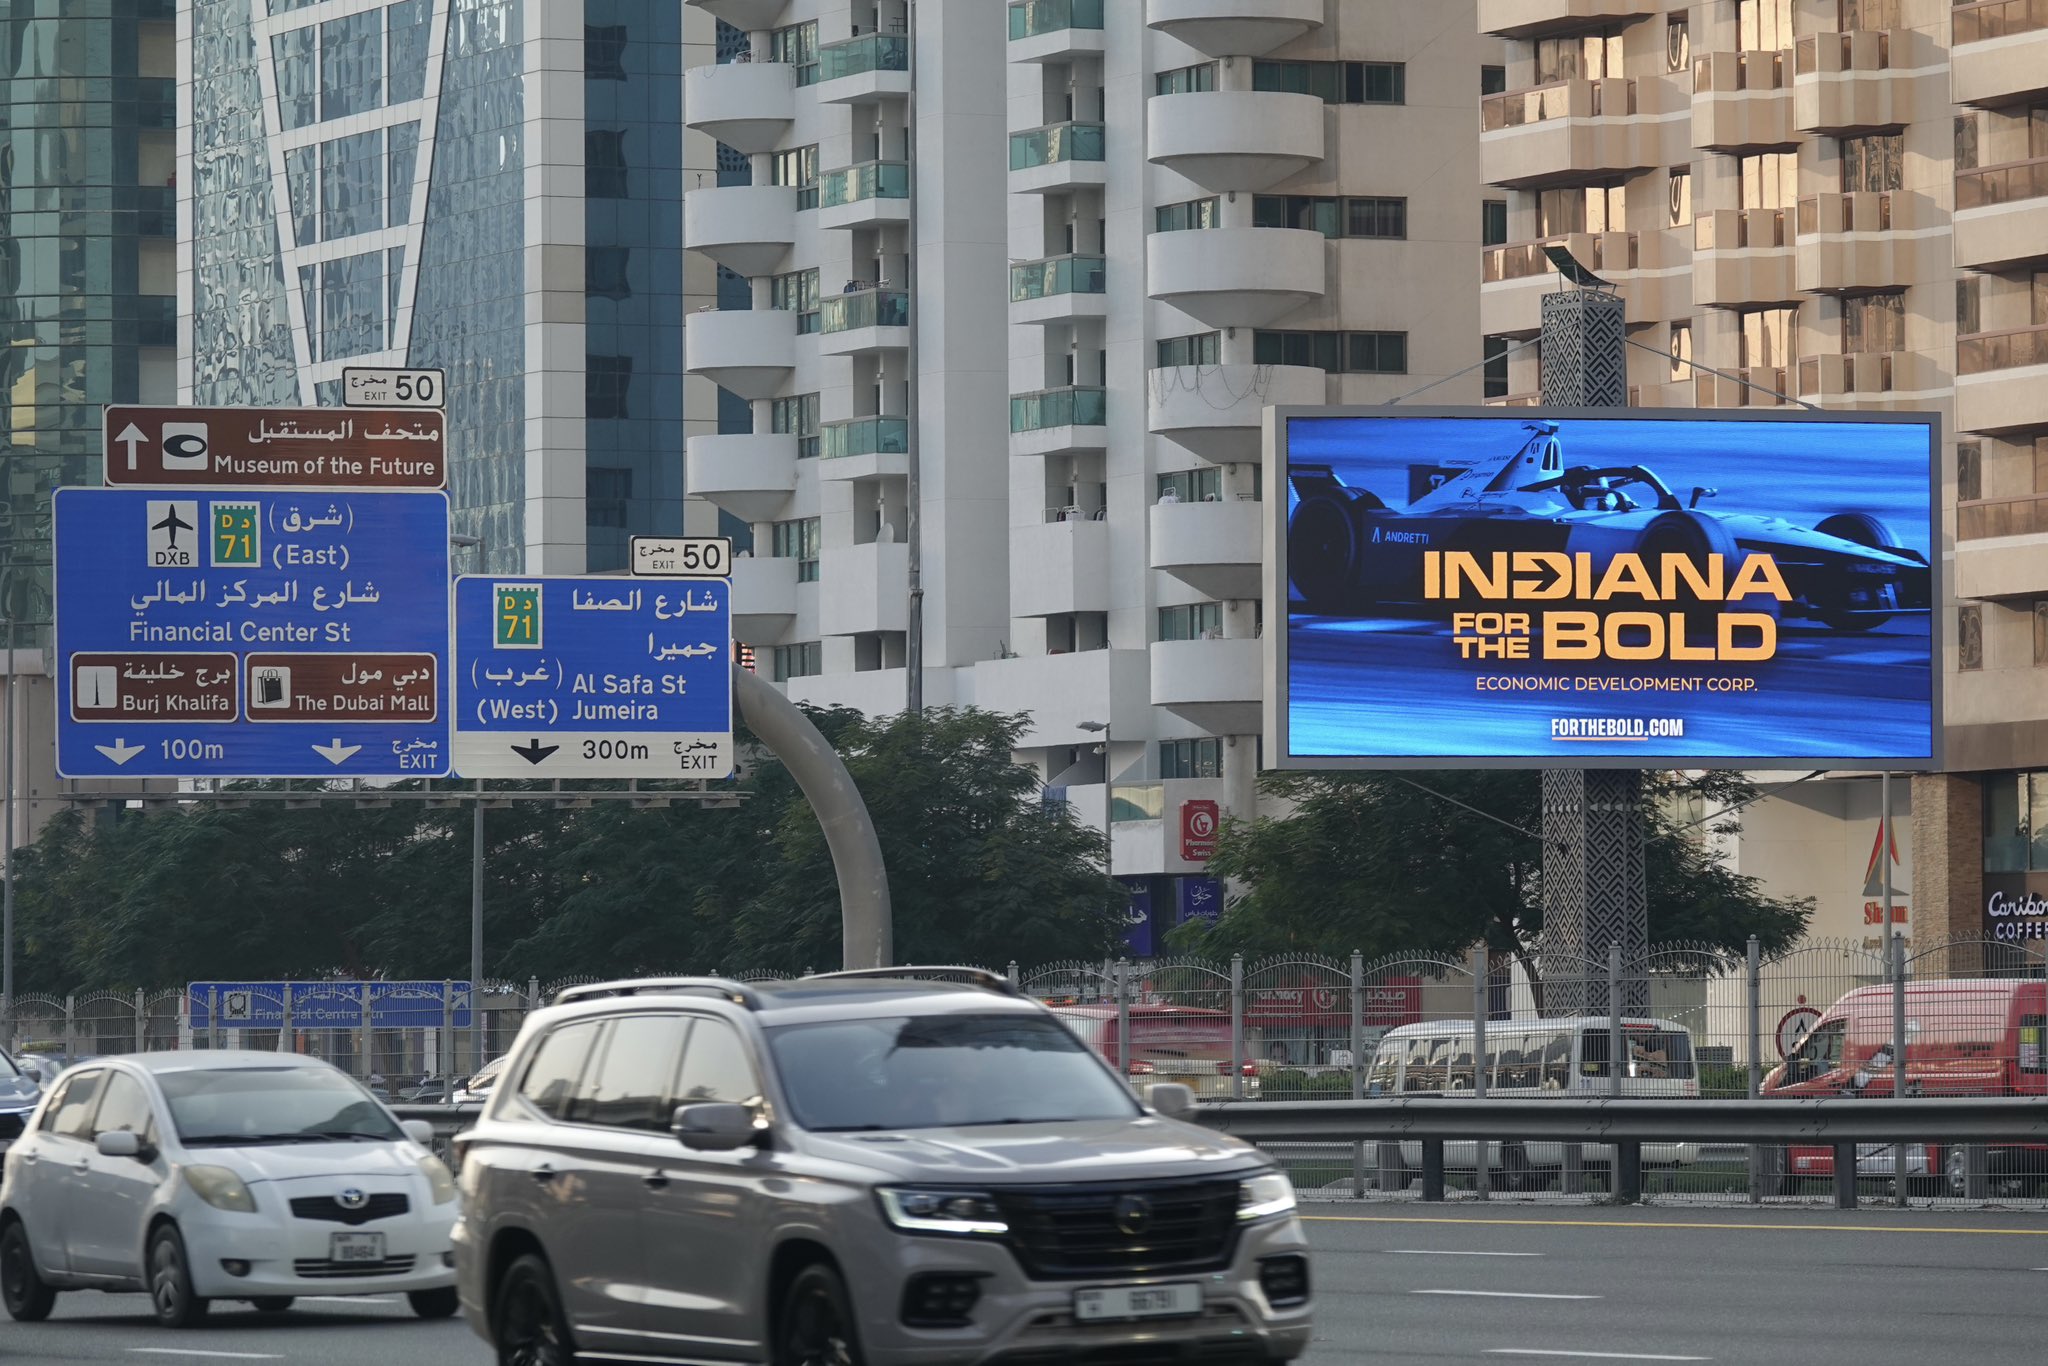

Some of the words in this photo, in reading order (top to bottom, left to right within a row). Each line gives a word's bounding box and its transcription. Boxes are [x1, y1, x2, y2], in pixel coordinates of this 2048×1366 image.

[351, 375, 387, 387] مخرج
[395, 375, 434, 401] 50
[364, 391, 387, 400] EXIT
[248, 418, 353, 444] المستقبل
[364, 419, 439, 443] متحف
[215, 455, 299, 475] Museum
[304, 456, 325, 475] of
[330, 457, 362, 475] the
[370, 457, 435, 476] Future
[222, 514, 233, 528] D
[241, 518, 251, 528] د
[220, 534, 251, 558] 71
[1385, 531, 1430, 544] ANDRETTI
[155, 551, 190, 565] DXB
[272, 544, 350, 571] (East)
[639, 544, 675, 556] مخرج
[683, 544, 721, 569] 50
[652, 560, 675, 569] EXIT
[1424, 550, 1793, 601] INDIANA
[130, 579, 205, 616] المالي
[216, 579, 298, 610] المركز
[312, 580, 380, 611] شارع
[504, 596, 516, 610] D
[523, 599, 532, 610] د
[572, 588, 641, 612] الصفا
[655, 590, 718, 619] شارع
[130, 621, 233, 642] Financial
[240, 622, 316, 642] Center
[324, 622, 351, 642] St
[503, 615, 532, 639] 71
[1453, 612, 1530, 635] FOR
[648, 632, 718, 661] جميرا
[1543, 611, 1777, 661] BOLD
[1453, 636, 1530, 659] THE
[123, 662, 185, 681] خليفة
[195, 667, 231, 687] برج
[341, 662, 383, 685] مول
[392, 665, 430, 690] دبي
[572, 674, 596, 694] Al
[603, 674, 654, 694] Safa
[661, 674, 687, 695] St
[1475, 676, 1570, 691] ECONOMIC
[1574, 676, 1703, 692] DEVELOPMENT
[1706, 677, 1759, 692] CORP.
[122, 695, 159, 713] Burj
[166, 695, 230, 711] Khalifa
[296, 695, 328, 710] The
[333, 695, 385, 711] Dubai
[391, 695, 430, 711] Mall
[476, 699, 558, 724] (West)
[572, 700, 659, 720] Jumeira
[1551, 718, 1684, 738] FORTHEBOLD.COM
[161, 739, 224, 760] 100m
[391, 737, 438, 754] مخرج
[582, 740, 649, 760] 300m
[673, 738, 718, 755] مخرج
[400, 755, 438, 769] EXIT
[680, 756, 718, 770] EXIT
[1988, 891, 2048, 917] Caribo
[255, 1008, 311, 1020] Finacial
